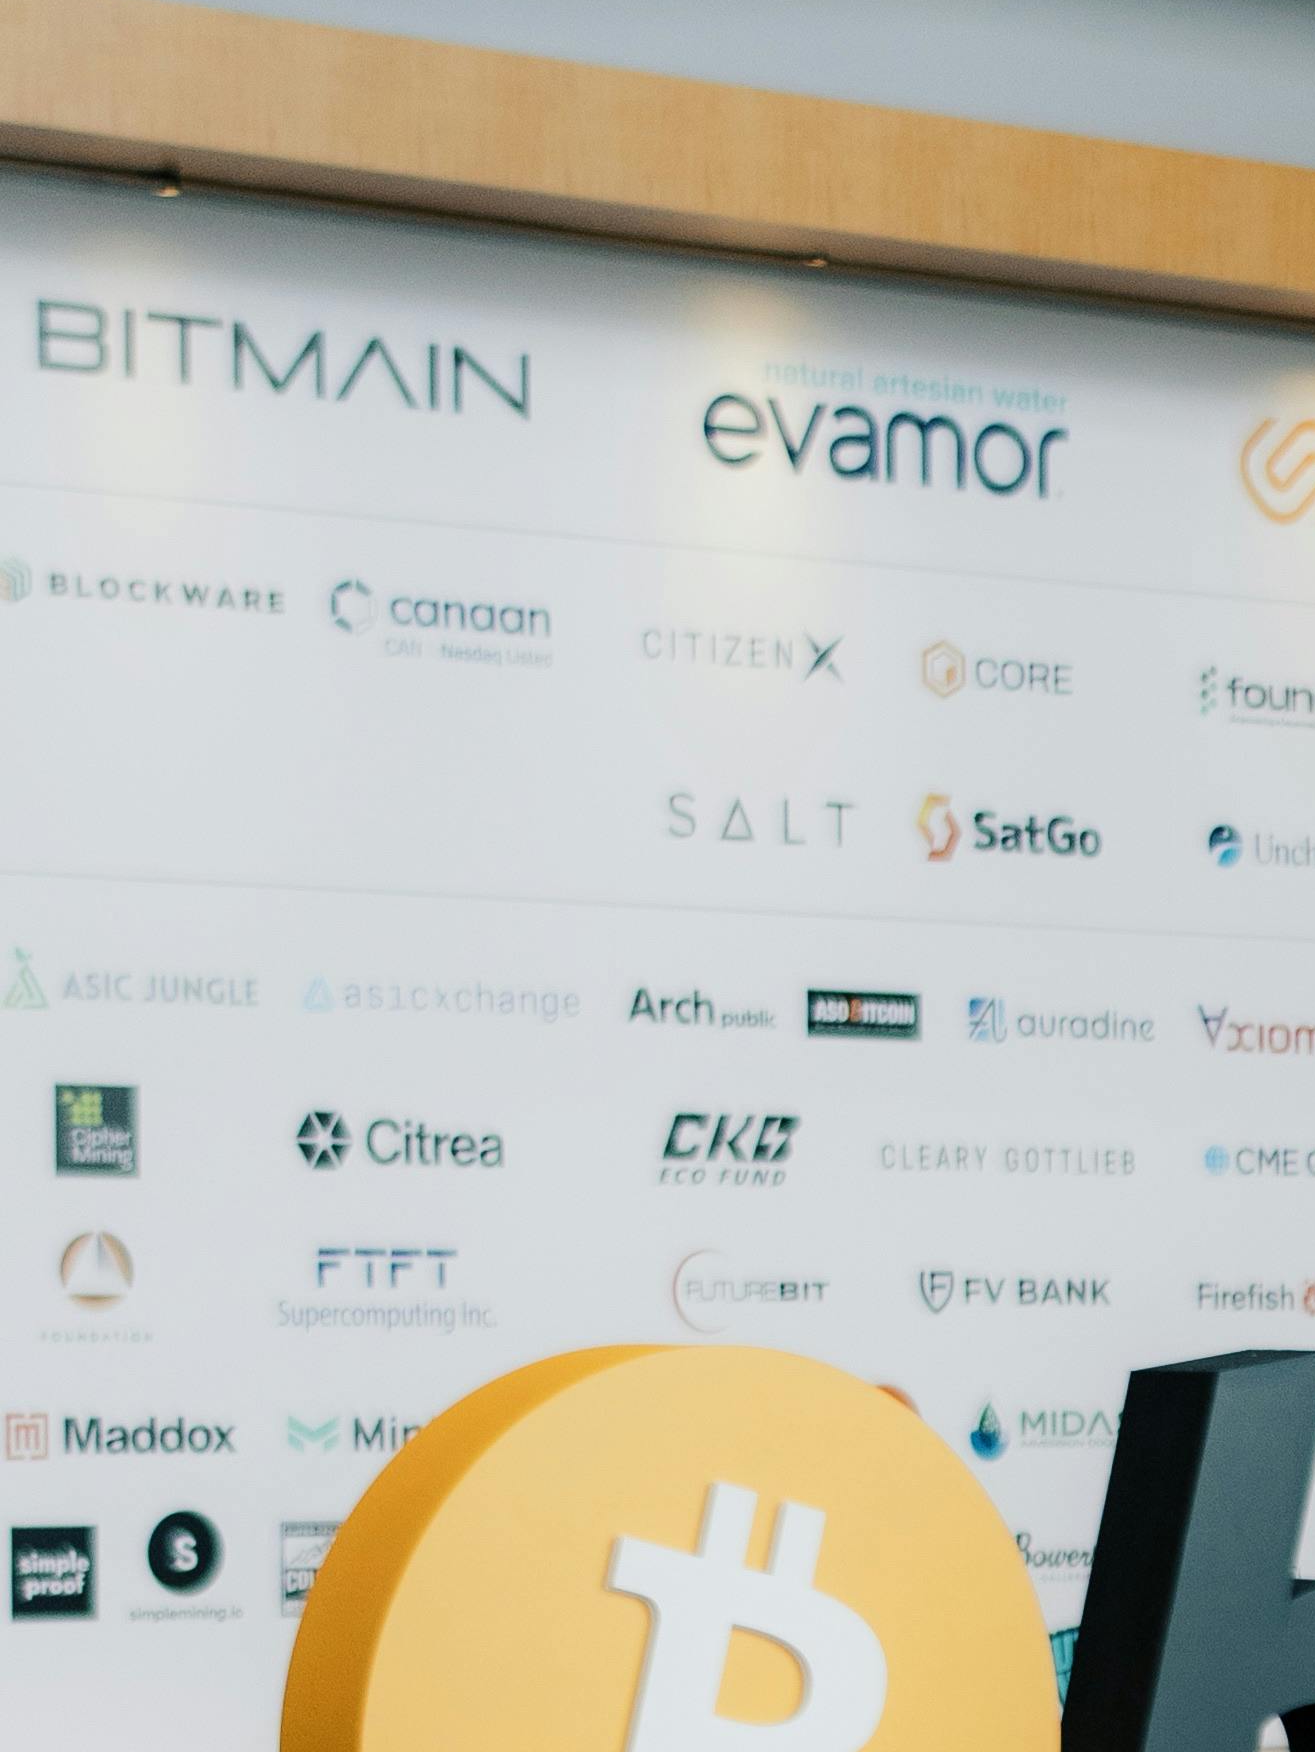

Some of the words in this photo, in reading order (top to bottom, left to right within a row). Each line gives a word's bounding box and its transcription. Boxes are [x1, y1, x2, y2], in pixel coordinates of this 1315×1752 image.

[37, 298, 531, 421] BITMAIN
[765, 361, 862, 392] natural
[874, 369, 982, 405] artesian
[994, 386, 1067, 414] water
[703, 392, 1068, 500] evamor
[49, 572, 286, 615] BLOCKWARE
[388, 590, 552, 637] canaan
[974, 658, 1074, 695] CORE
[667, 793, 854, 847] SALT
[972, 810, 1102, 858] SatGo
[62, 973, 134, 1004] ASIC
[143, 975, 260, 1008] JUNGLE
[343, 980, 582, 1023] asicxchange
[629, 987, 715, 1026] Arch
[1016, 1008, 1155, 1042] auradine
[71, 1126, 134, 1152] Cipher
[366, 1119, 504, 1168] Citrea
[662, 1113, 801, 1162] CKB
[71, 1145, 135, 1172] Mining
[880, 1144, 988, 1173] CLEARY
[1004, 1147, 1137, 1177] GOTTLIEB
[1236, 1148, 1299, 1177] CME
[659, 1167, 707, 1186] ECO
[719, 1167, 787, 1188] FUND
[317, 1247, 457, 1288] FTFT
[685, 1279, 830, 1303] FUTUREBIT
[964, 1278, 1006, 1304] FV
[1018, 1278, 1111, 1306] BANK
[1199, 1282, 1296, 1314] Firefish
[278, 1300, 456, 1335] Supercomputing
[461, 1302, 498, 1329] Inc.
[63, 1416, 236, 1454] Maddox
[1019, 1409, 1124, 1437] MIDA
[17, 1549, 91, 1577] simple
[21, 1573, 88, 1602] proof
